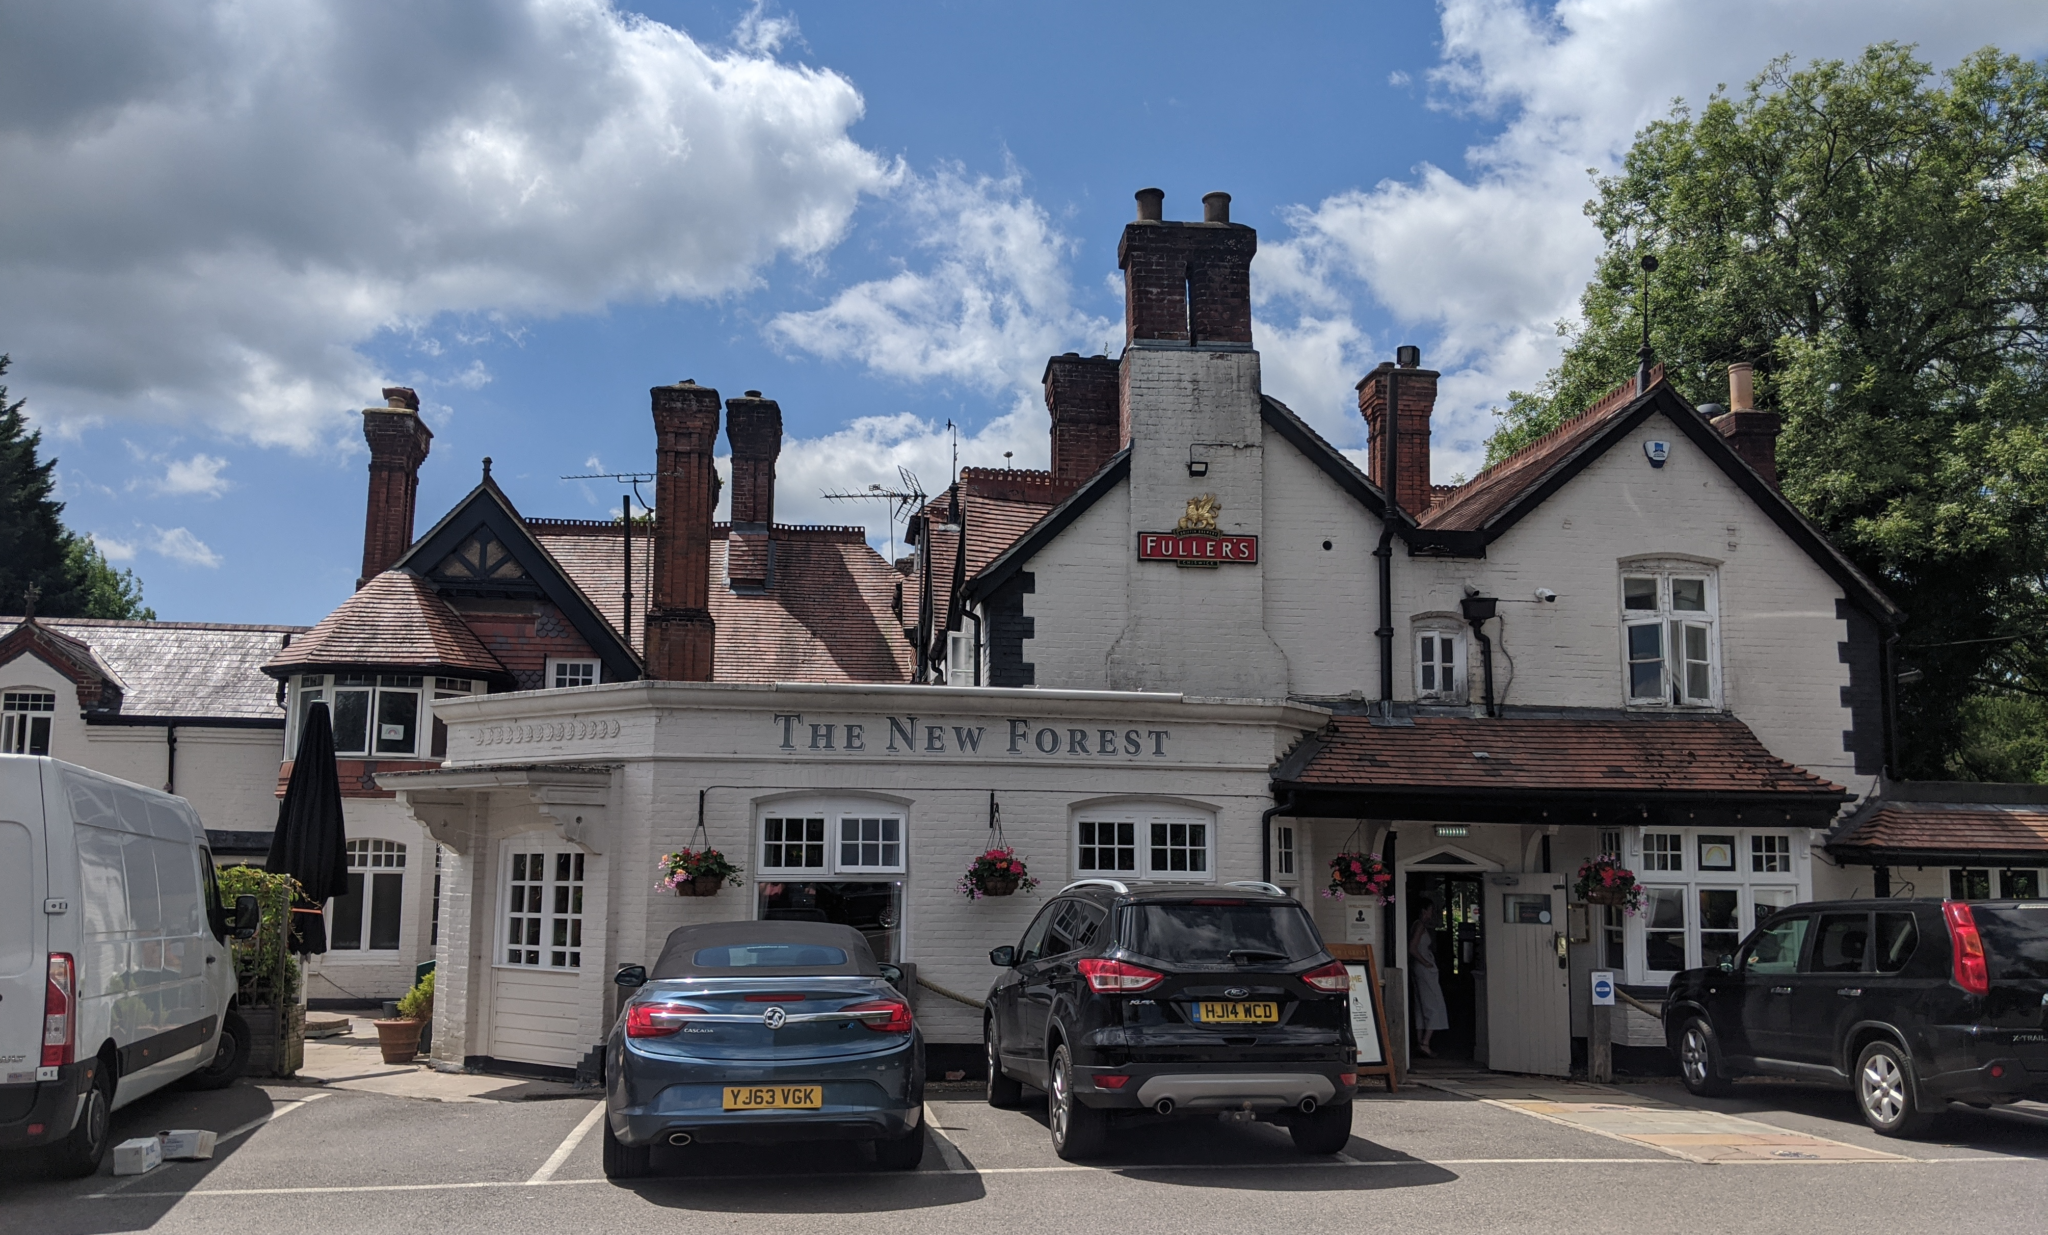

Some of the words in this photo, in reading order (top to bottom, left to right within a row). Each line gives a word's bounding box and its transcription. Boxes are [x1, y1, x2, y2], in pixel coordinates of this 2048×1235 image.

[1147, 537, 1249, 558] FULLER'S
[774, 713, 865, 751] THE
[886, 716, 986, 753] NEW
[1006, 719, 1171, 757] FOREST
[1205, 1004, 1239, 1019] HJ14
[1243, 1003, 1272, 1019] WCD
[2012, 1034, 2047, 1042] X-TRAIL
[730, 1088, 776, 1106] YJ63
[781, 1088, 814, 1105] VGK
